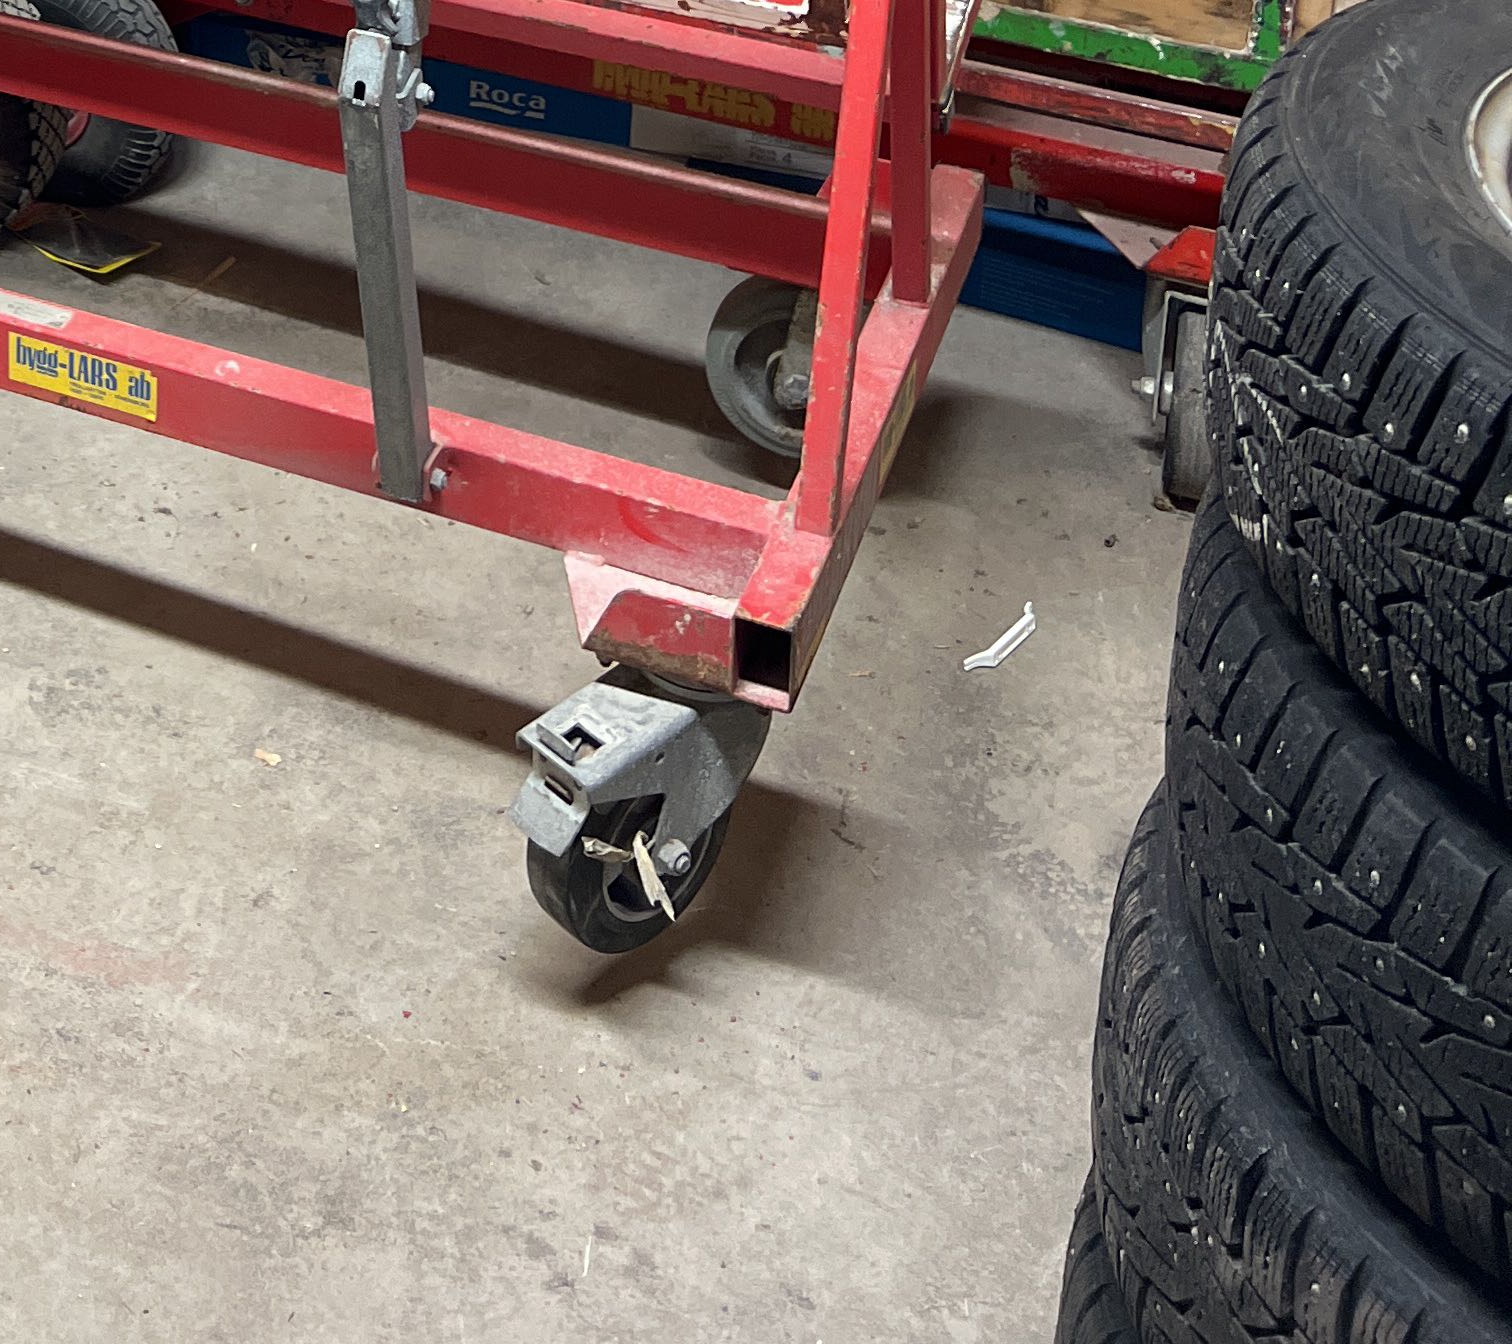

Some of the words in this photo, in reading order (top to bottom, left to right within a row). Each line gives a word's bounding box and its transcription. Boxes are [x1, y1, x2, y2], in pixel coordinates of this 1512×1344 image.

[469, 79, 547, 110] Roca
[15, 336, 118, 391] bygg-LARS
[128, 371, 152, 401] ab
